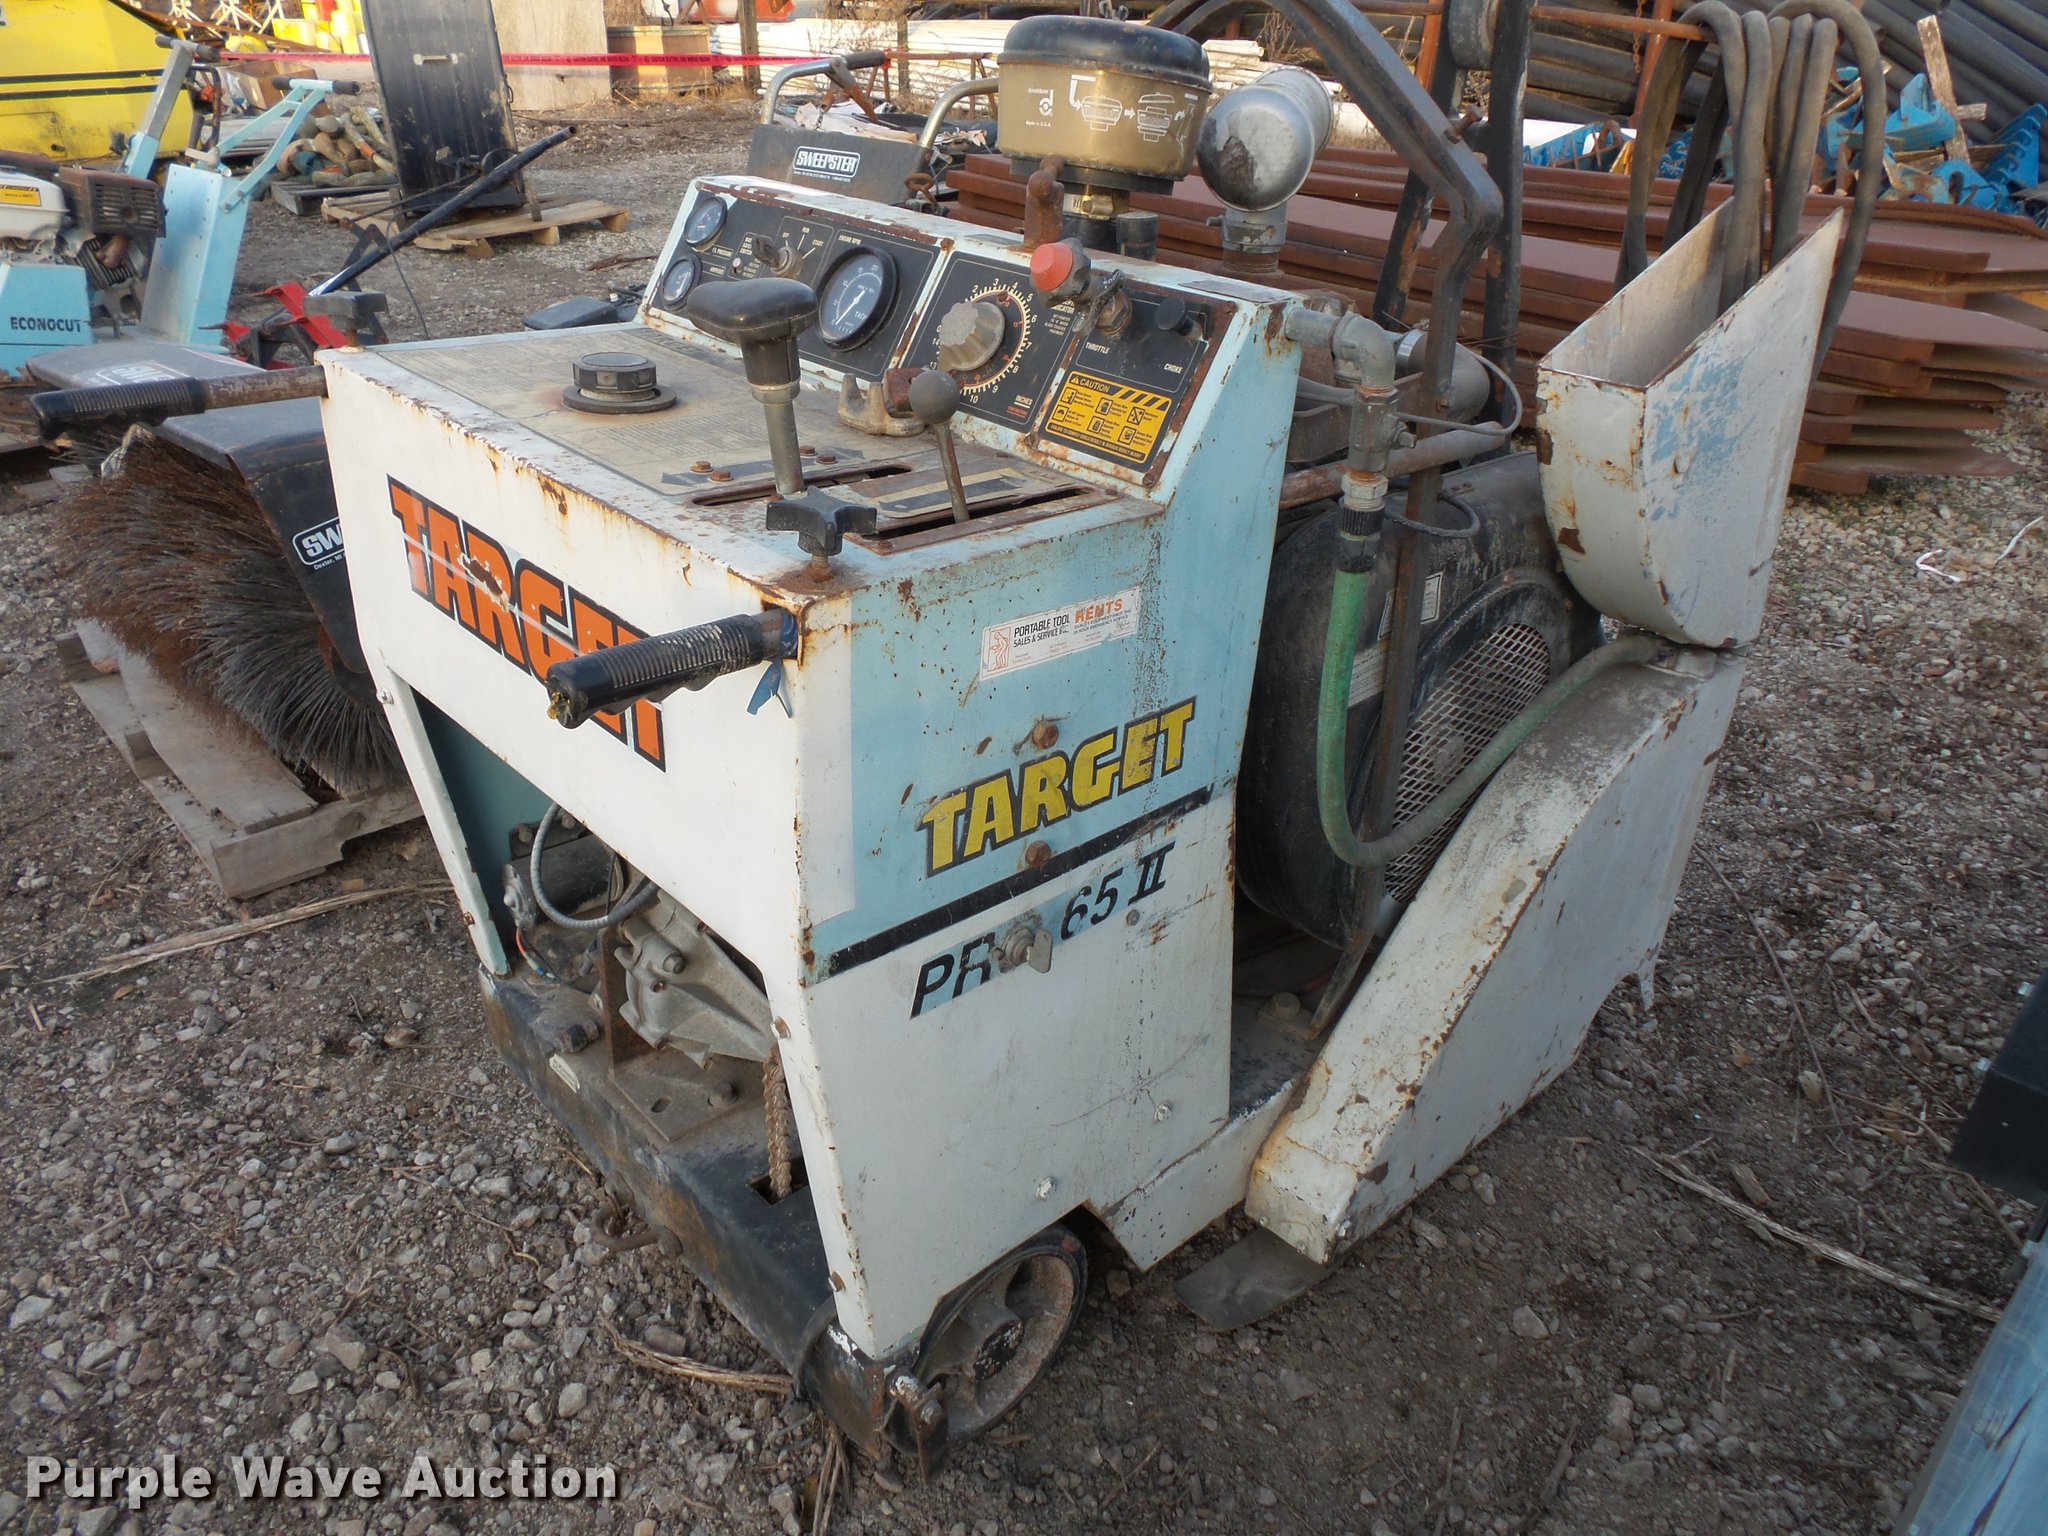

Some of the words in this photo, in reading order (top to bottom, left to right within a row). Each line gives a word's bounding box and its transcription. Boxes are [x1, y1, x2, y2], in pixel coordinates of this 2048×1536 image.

[796, 150, 858, 173] SWEEPSTER
[993, 278, 999, 286] 3
[1011, 281, 1019, 289] 4
[972, 285, 979, 293] 2
[1027, 293, 1034, 301] 5
[10, 316, 81, 333] ECONOCUT
[1031, 315, 1037, 323] 6
[1025, 342, 1032, 350] 7
[1085, 341, 1110, 355] THROTTLE
[1013, 365, 1020, 373] 8
[1163, 363, 1184, 374] CHOKE
[992, 385, 999, 393] 9
[1079, 378, 1110, 393] CAUTION
[970, 395, 979, 404] 10
[1015, 394, 1033, 406] INCHES
[1074, 598, 1123, 625] RENTS
[1013, 619, 1051, 638] PORTABLE
[1052, 614, 1070, 627] TOOL
[1013, 636, 1031, 648] SALES
[1031, 635, 1036, 643] &
[1036, 627, 1059, 642] SERVICE
[916, 695, 1197, 878] TARGET
[1060, 867, 1124, 941] 65
[1127, 840, 1177, 907] II
